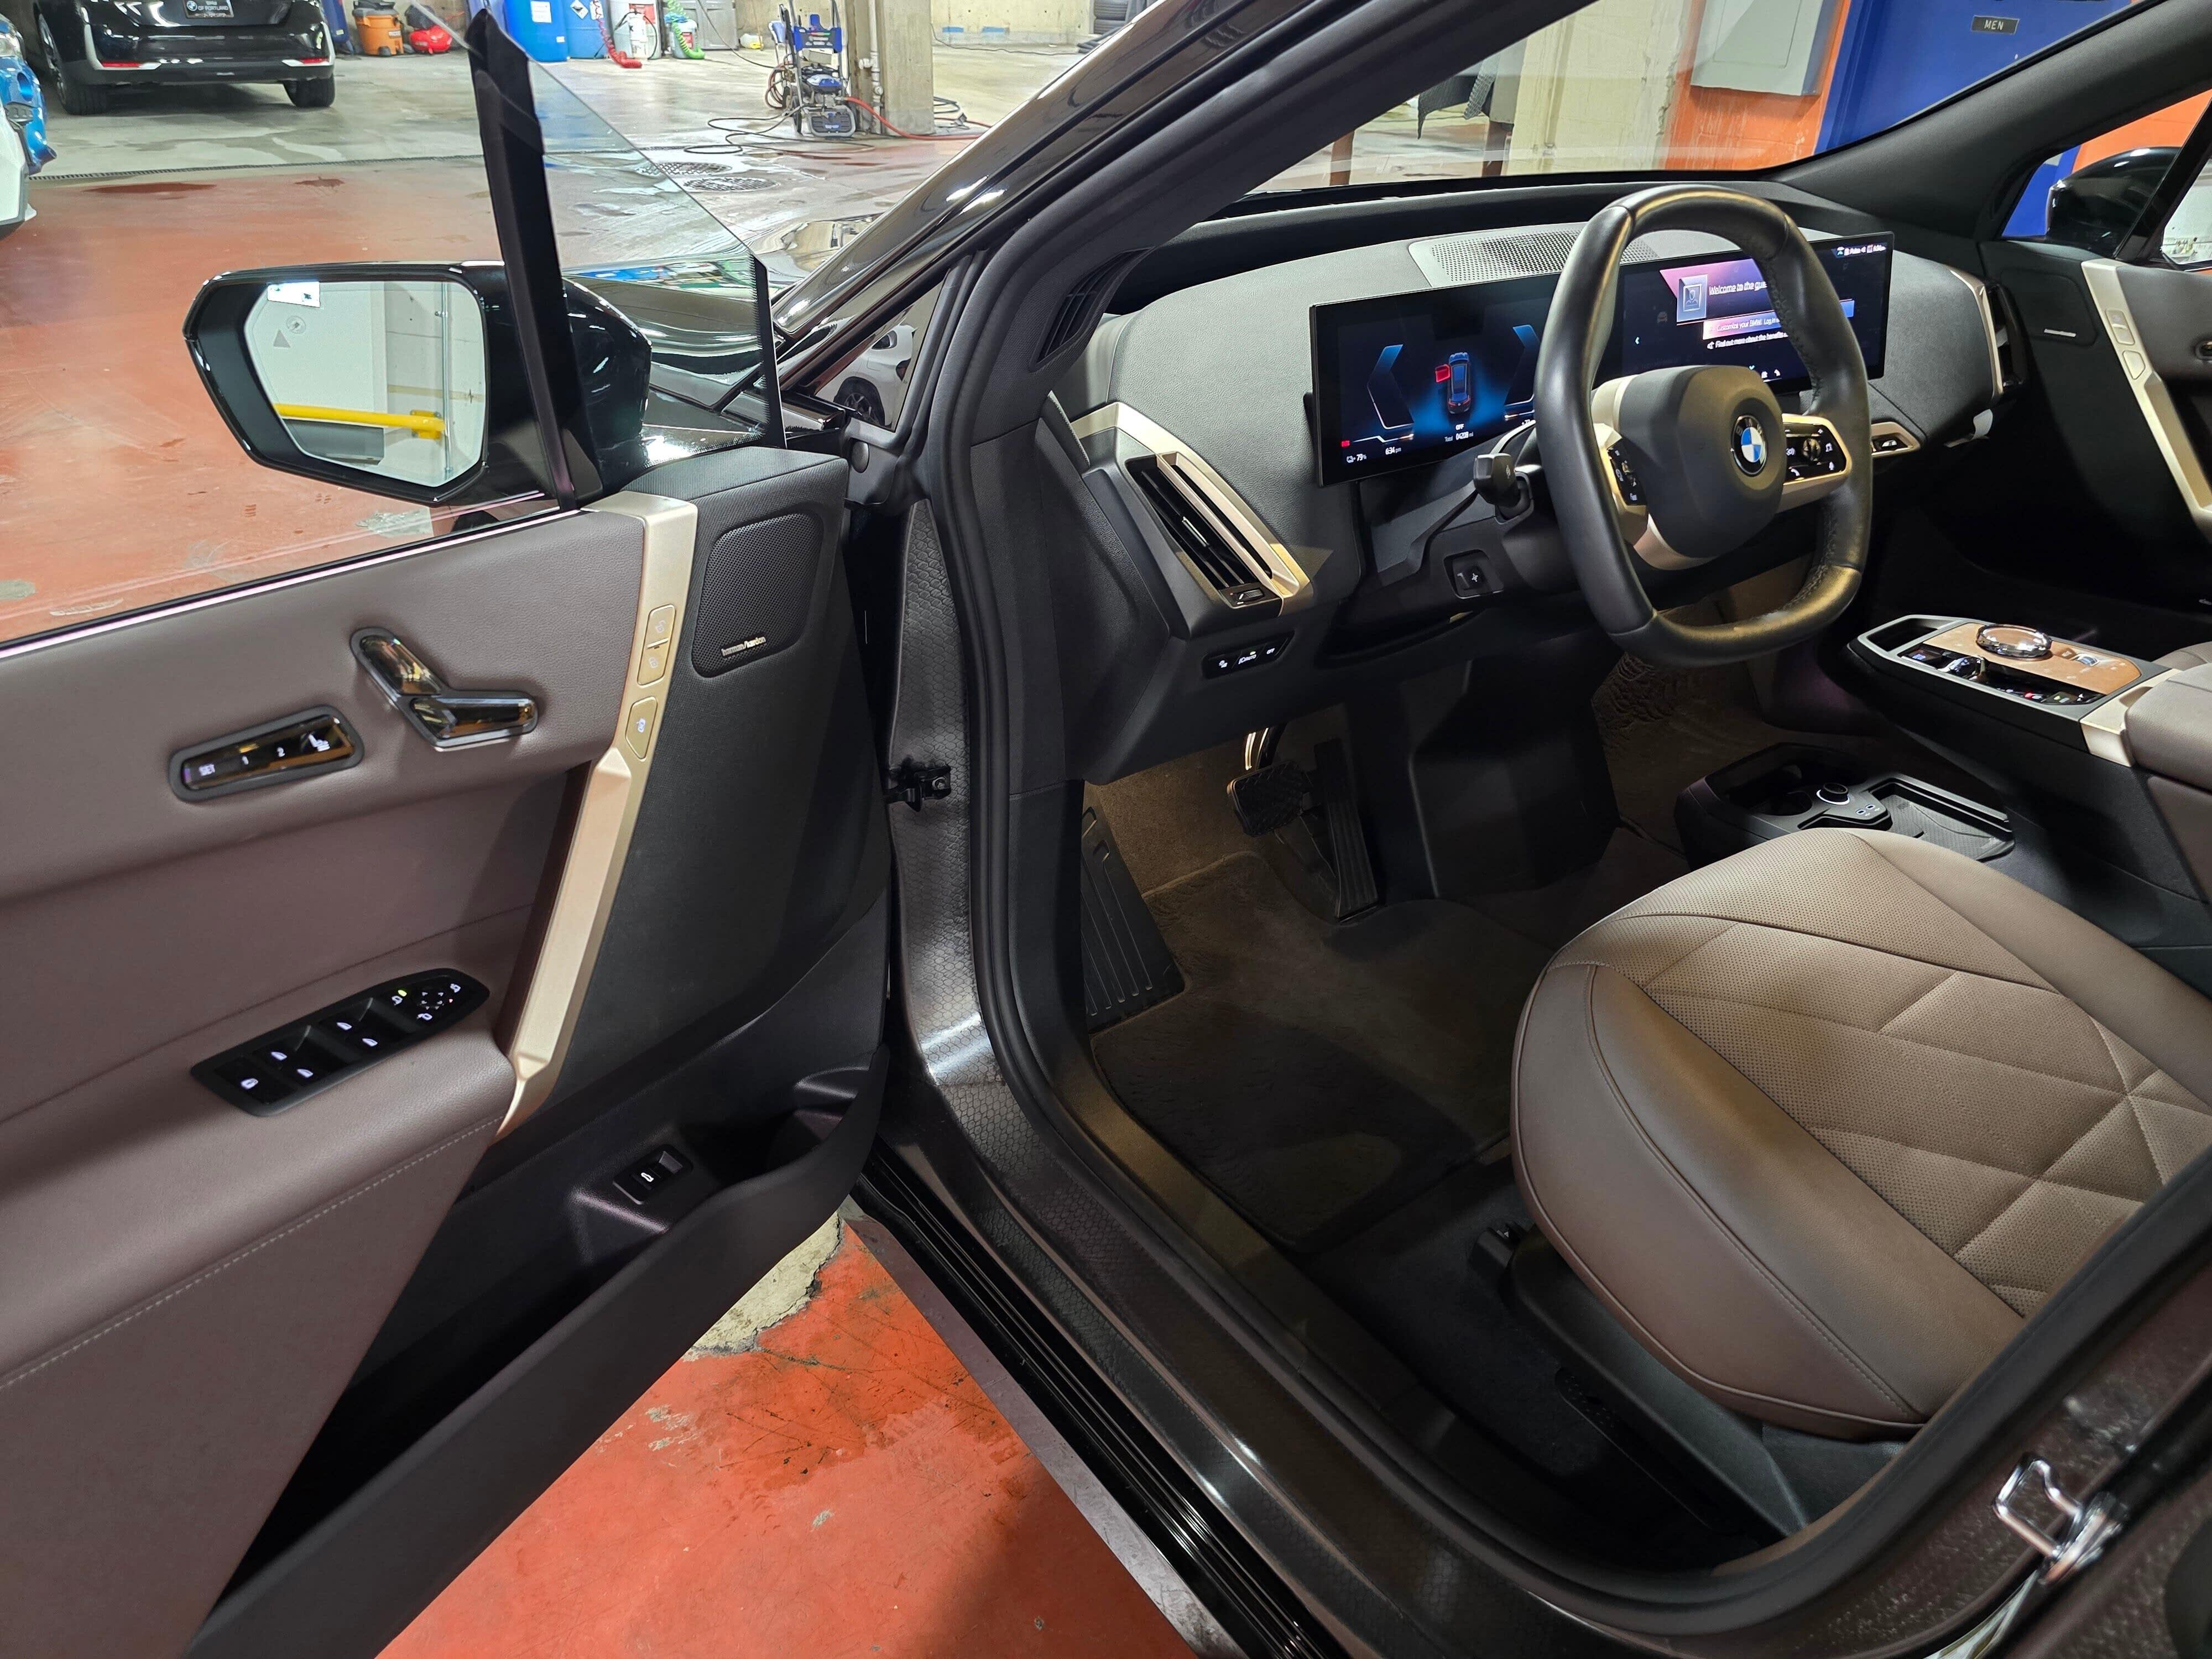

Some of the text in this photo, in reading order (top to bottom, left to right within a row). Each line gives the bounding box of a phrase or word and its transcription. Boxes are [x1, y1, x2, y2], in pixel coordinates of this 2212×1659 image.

[1984, 19, 2004, 30] MEN
[1709, 285, 1736, 296] Welcome
[1736, 283, 1744, 291] to
[1744, 281, 1754, 291] the
[1739, 321, 1749, 330] your
[1715, 340, 1726, 348] Find
[1745, 335, 1759, 343] about
[277, 747, 285, 757] 2
[242, 755, 249, 765] 1
[199, 764, 216, 776] SET
